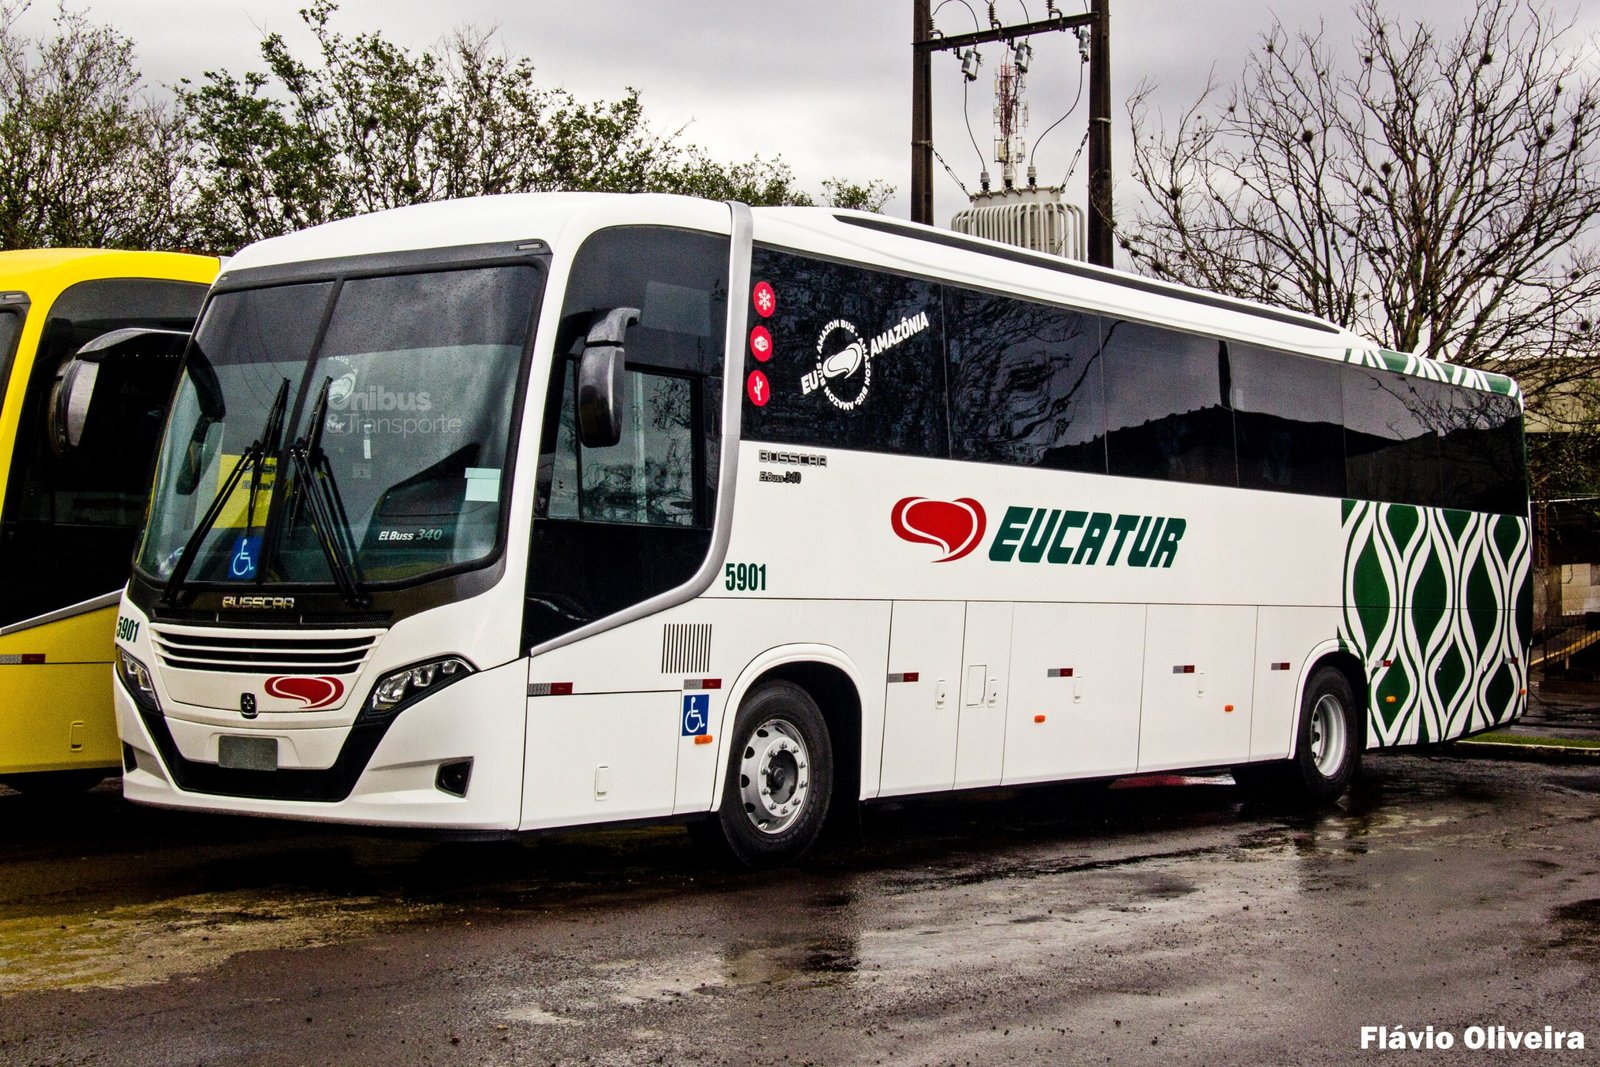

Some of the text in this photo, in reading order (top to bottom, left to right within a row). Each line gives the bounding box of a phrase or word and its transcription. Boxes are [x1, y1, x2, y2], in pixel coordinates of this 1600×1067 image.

[816, 319, 856, 354] AMAZON BUS
[800, 311, 930, 395] EU AMAZÔNIA
[816, 362, 854, 411] AMAZON BUS
[857, 337, 872, 405] AMAZON BUS
[758, 449, 828, 467] BUSSCAR
[416, 528, 443, 541] 340
[988, 505, 1187, 568] EUCATUR
[724, 562, 767, 591] 5901
[222, 595, 295, 609] BUSSCAR
[116, 616, 141, 643] 5901
